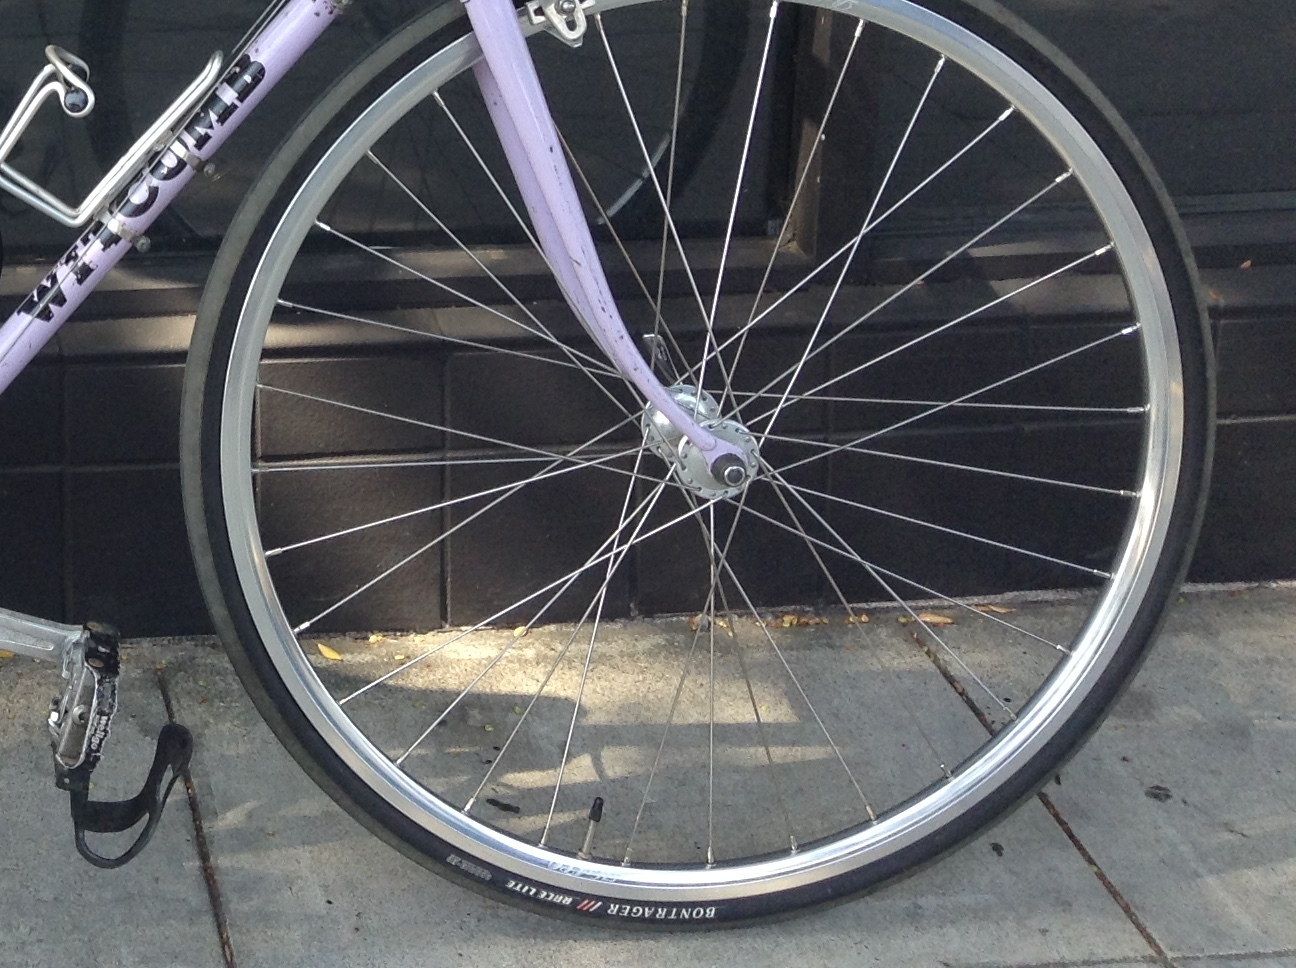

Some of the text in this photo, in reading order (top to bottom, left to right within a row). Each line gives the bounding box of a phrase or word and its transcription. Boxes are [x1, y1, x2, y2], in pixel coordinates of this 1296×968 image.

[505, 878, 717, 921] BONTRAGER RACE LITE
